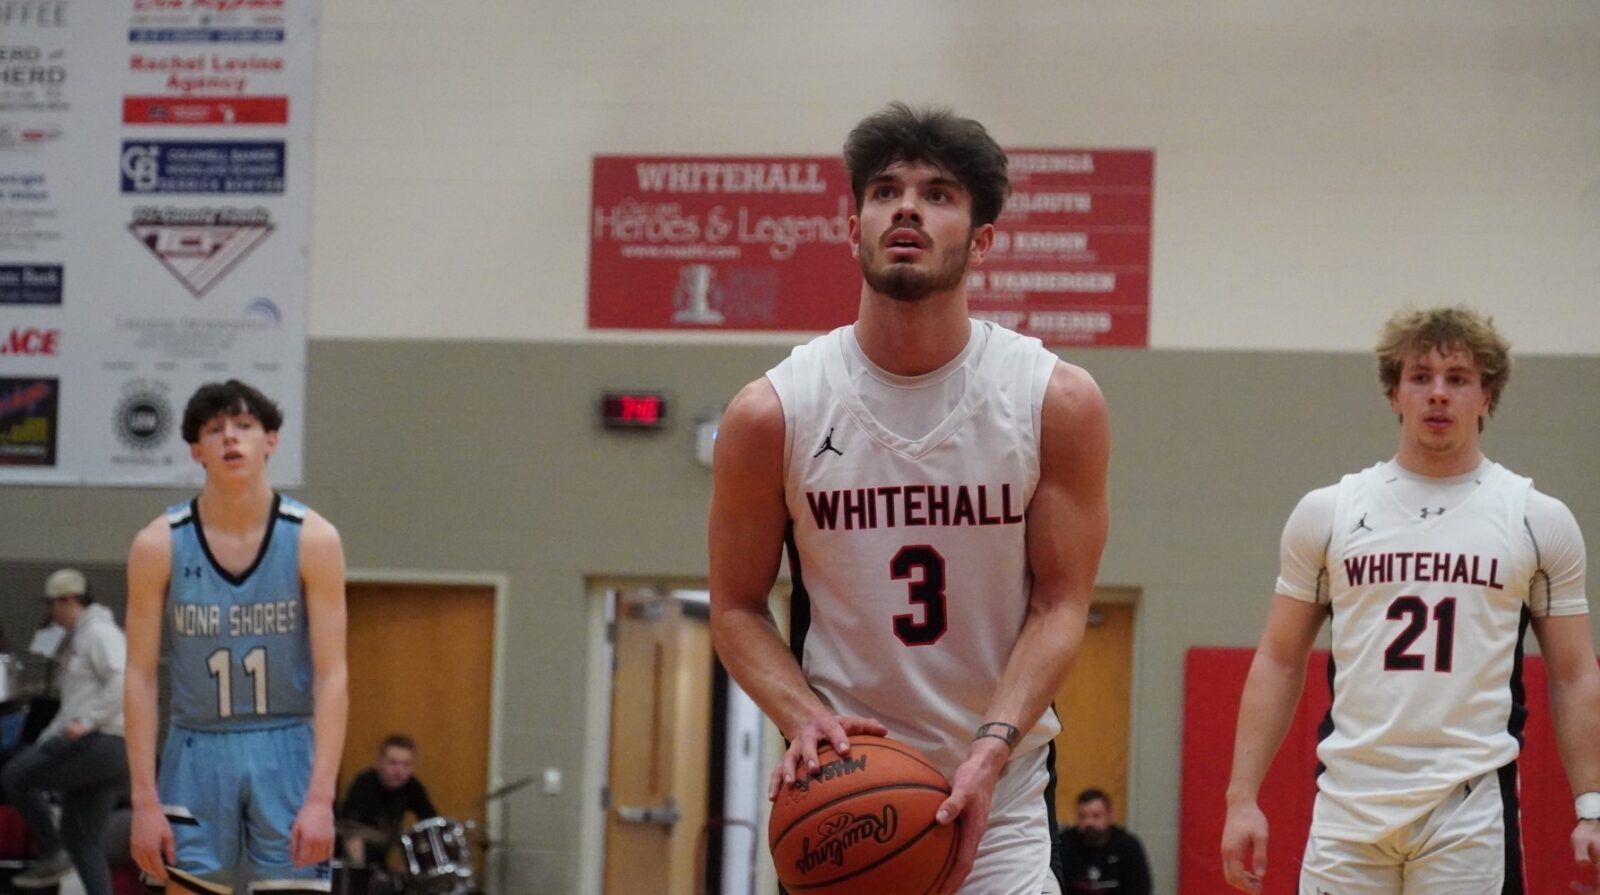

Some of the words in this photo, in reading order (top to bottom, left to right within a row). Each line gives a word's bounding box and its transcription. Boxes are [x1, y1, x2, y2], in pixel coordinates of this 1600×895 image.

[0, 0, 67, 27] FFEE
[167, 73, 246, 91] Agency
[636, 162, 827, 193] WHITEHALL
[594, 206, 700, 243] Heroes
[705, 205, 733, 243] &
[738, 195, 849, 261] Legend
[1, 328, 60, 356] ACE
[806, 482, 1024, 531] WHITEHALL
[1344, 552, 1504, 590] WHITEHALL
[889, 544, 948, 647] 3
[229, 600, 297, 636] SHORES
[1383, 595, 1457, 673] 21
[206, 645, 268, 718] 11
[794, 803, 899, 876] Rawlings
